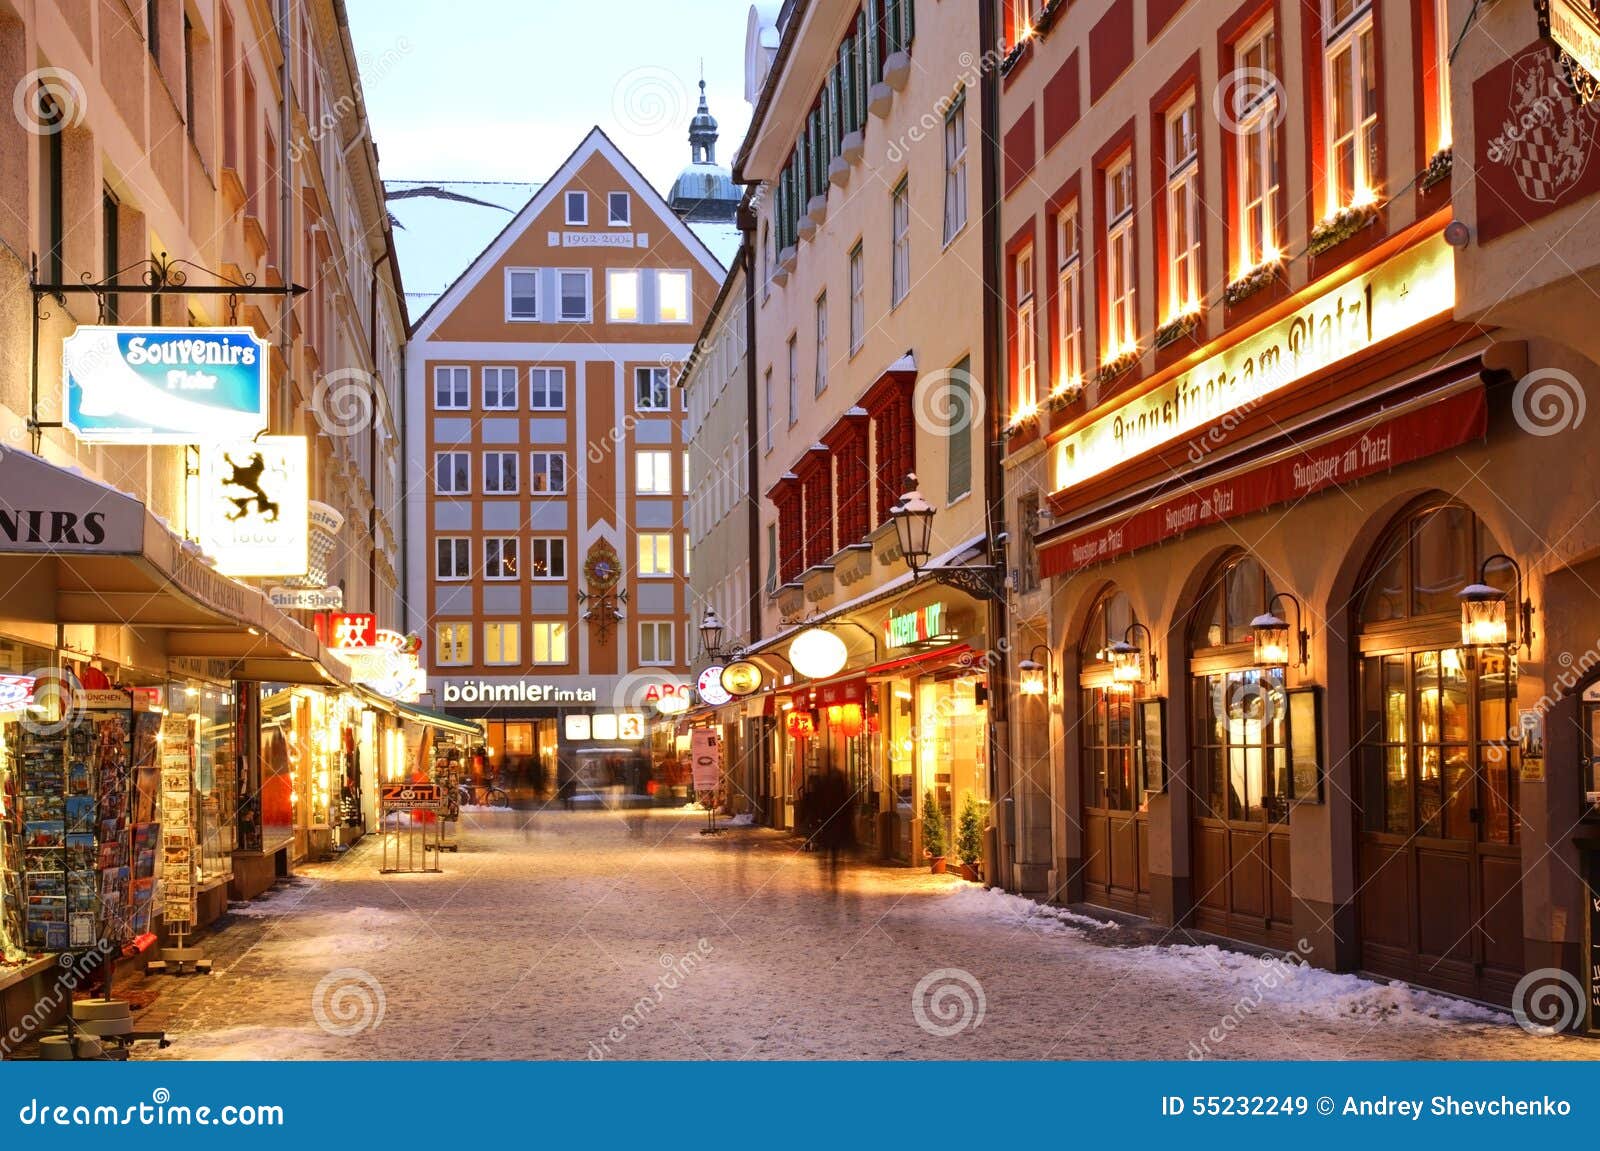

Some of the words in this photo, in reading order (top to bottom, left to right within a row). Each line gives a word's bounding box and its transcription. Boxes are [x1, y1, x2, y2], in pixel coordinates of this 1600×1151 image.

[1243, 344, 1280, 382] am
[1288, 282, 1373, 350] Platzl
[127, 337, 256, 365] Souvenirs
[1293, 455, 1340, 492] Augustiner
[1344, 449, 1358, 474] am
[1361, 434, 1391, 467] Platzl
[1200, 500, 1212, 518] am
[444, 681, 553, 702] böhmler
[555, 688, 575, 701] im
[576, 688, 596, 701] tal
